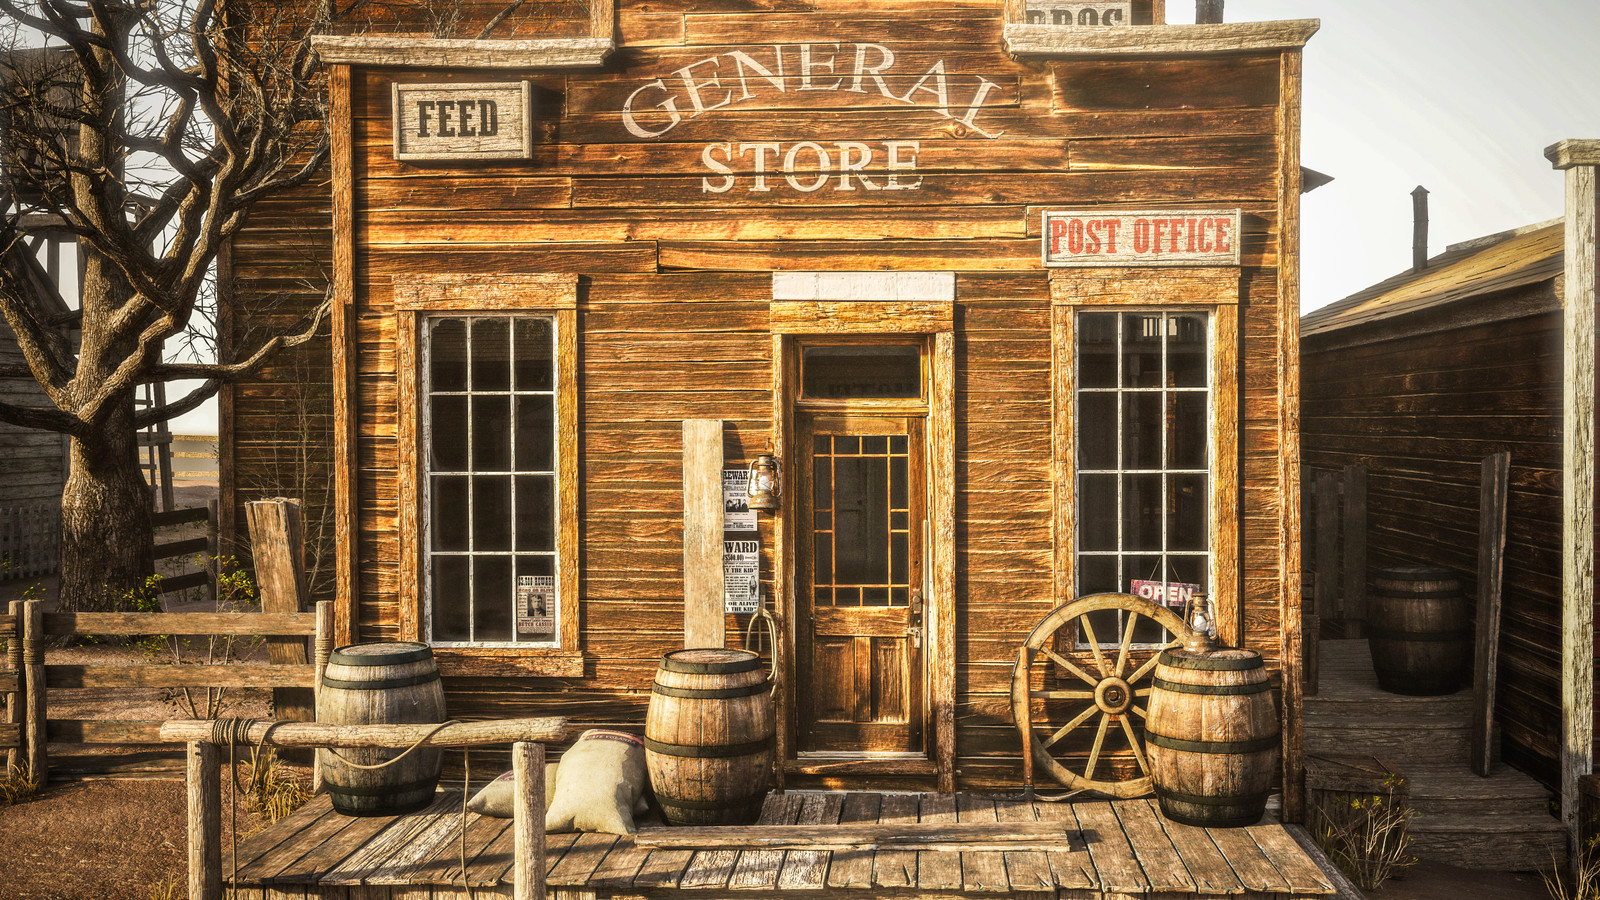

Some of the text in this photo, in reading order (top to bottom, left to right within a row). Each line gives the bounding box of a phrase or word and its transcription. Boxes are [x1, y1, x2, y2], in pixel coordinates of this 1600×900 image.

[622, 43, 1004, 140] GENERAL
[417, 100, 498, 137] FEED
[702, 141, 924, 194] STORE
[1050, 218, 1231, 254] POST OFFICE
[724, 471, 749, 479] REWAR
[725, 542, 757, 552] WARD
[1139, 585, 1193, 602] OPEN
